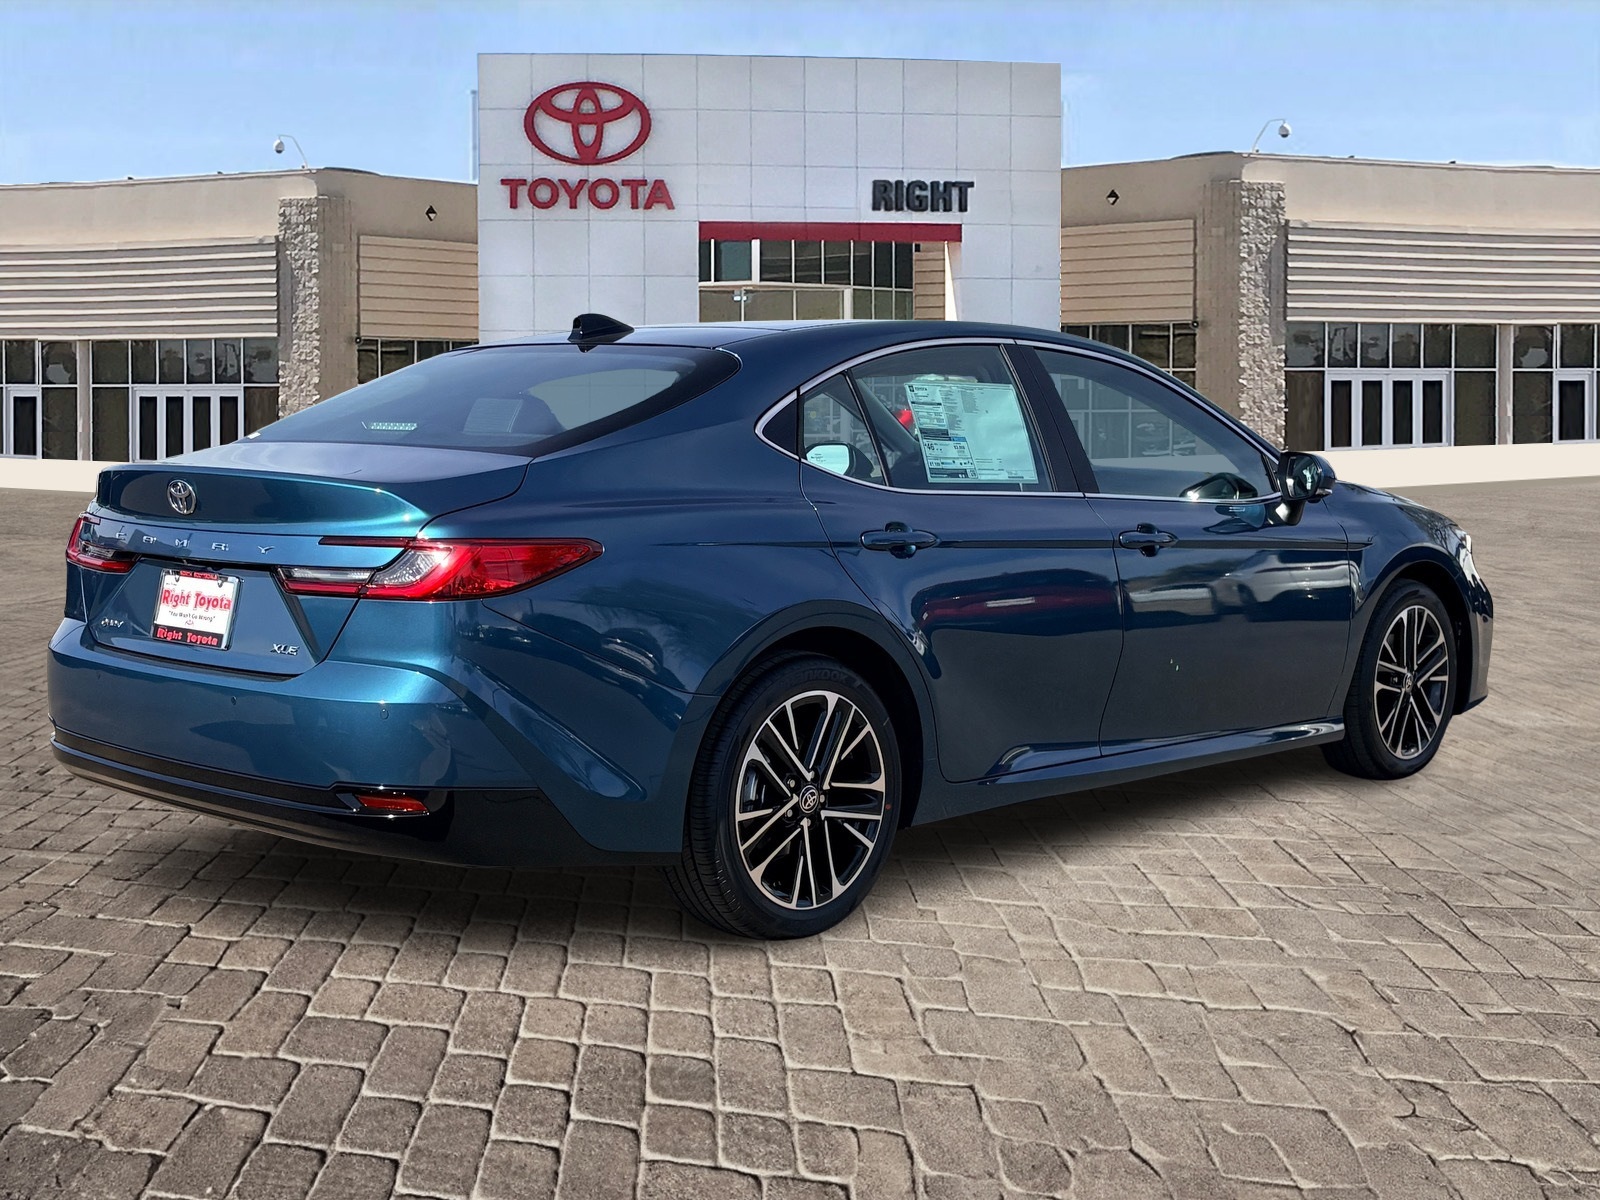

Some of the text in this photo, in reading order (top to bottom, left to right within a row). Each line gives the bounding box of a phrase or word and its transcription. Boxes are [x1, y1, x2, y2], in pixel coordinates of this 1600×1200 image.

[500, 178, 676, 210] TOYOTA
[872, 179, 975, 213] RIGHT
[162, 589, 232, 611] Right Toyota
[156, 627, 218, 646] Right Toyota
[270, 643, 300, 656] XLE
